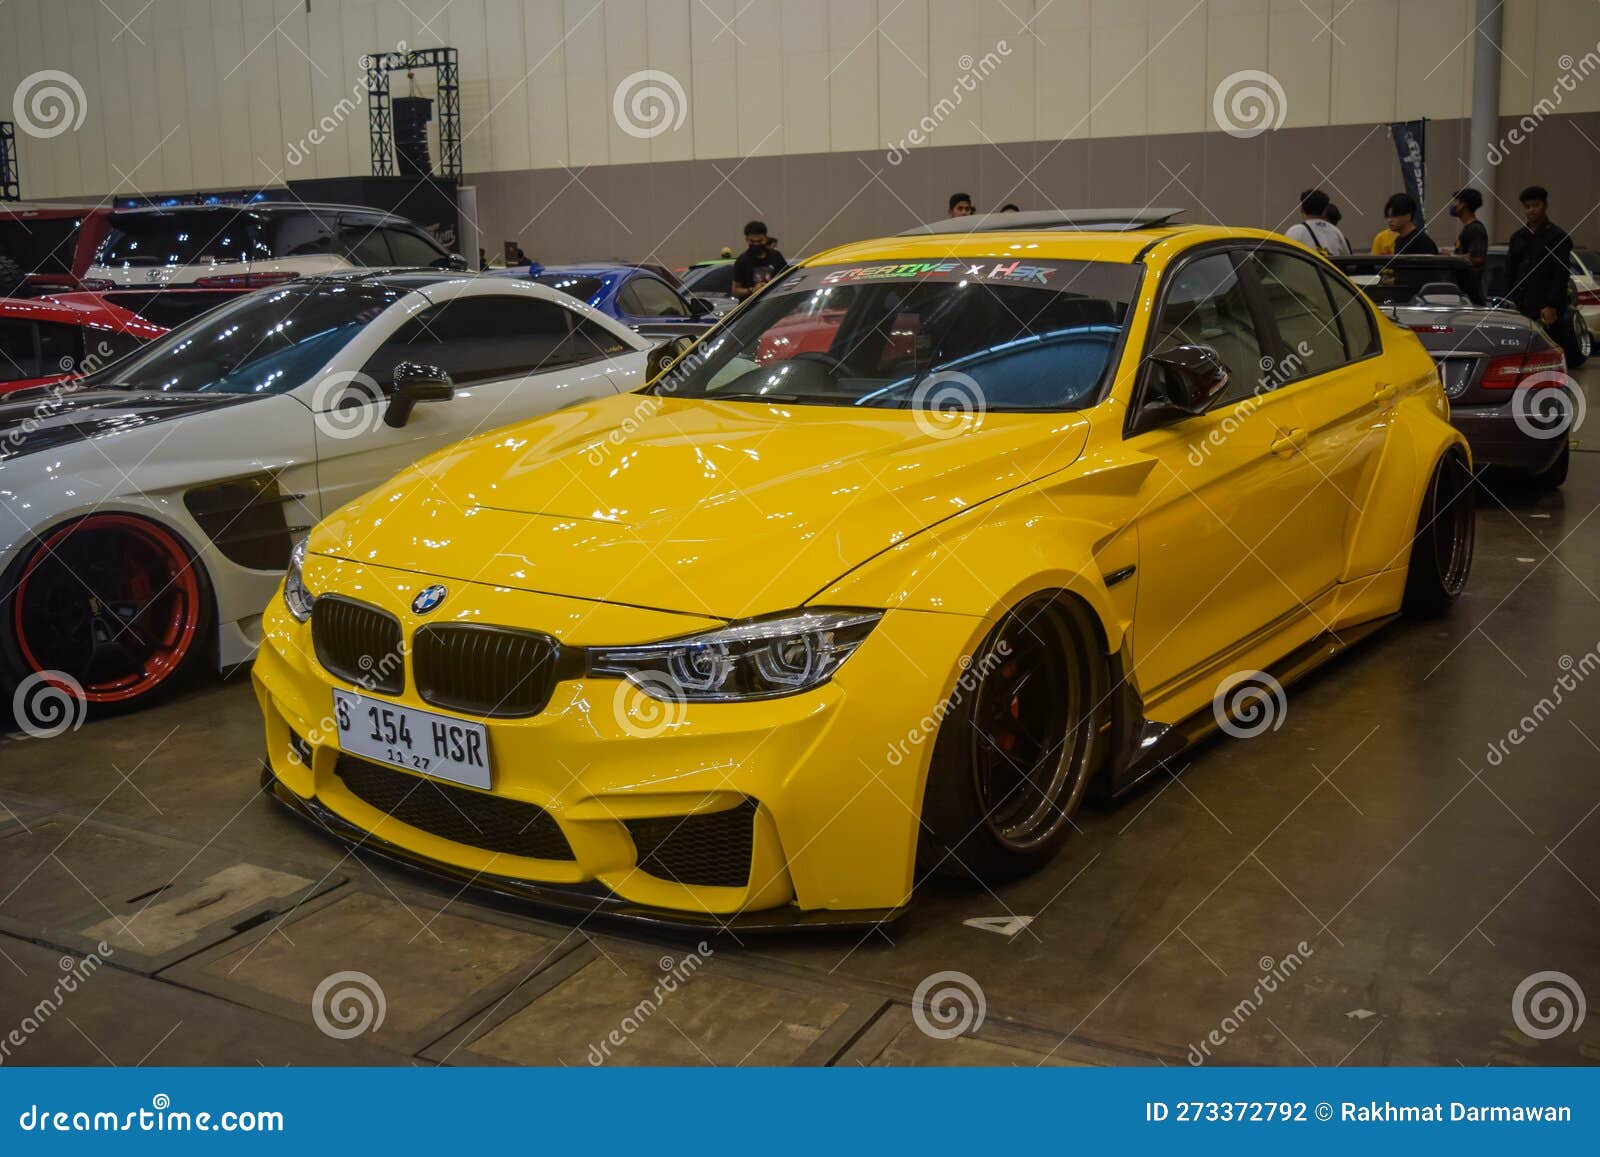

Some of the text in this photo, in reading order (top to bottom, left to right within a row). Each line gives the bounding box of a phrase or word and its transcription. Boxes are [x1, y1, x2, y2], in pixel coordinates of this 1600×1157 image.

[824, 263, 960, 280] CREATIVE
[369, 706, 413, 750] 154
[432, 721, 484, 768] HSR
[387, 749, 431, 770] 11 27
